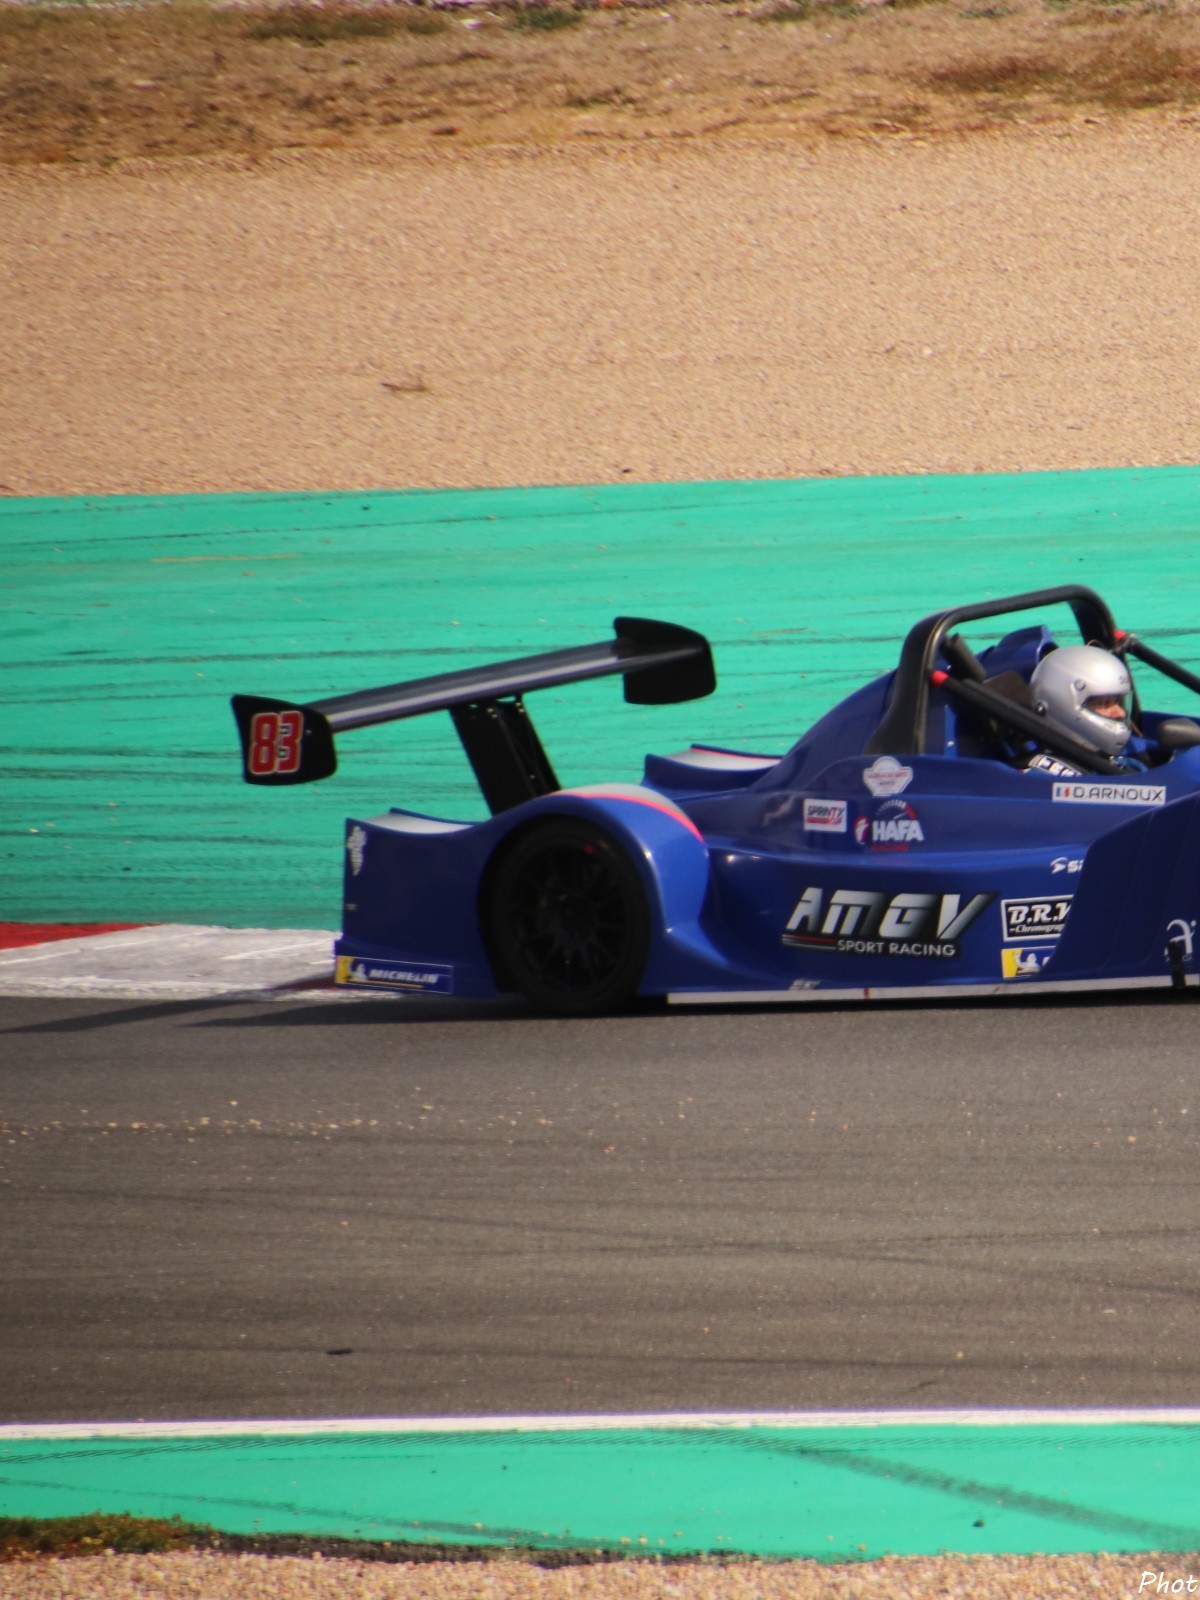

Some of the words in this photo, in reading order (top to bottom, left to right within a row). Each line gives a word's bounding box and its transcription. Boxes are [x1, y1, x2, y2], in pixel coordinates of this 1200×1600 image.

[248, 710, 304, 775] 83
[1073, 787, 1163, 801] D.ARNOUX
[872, 819, 924, 842] HAFA
[837, 939, 885, 954] SPORT
[888, 943, 956, 957] RACING
[368, 968, 440, 984] MICHELIN
